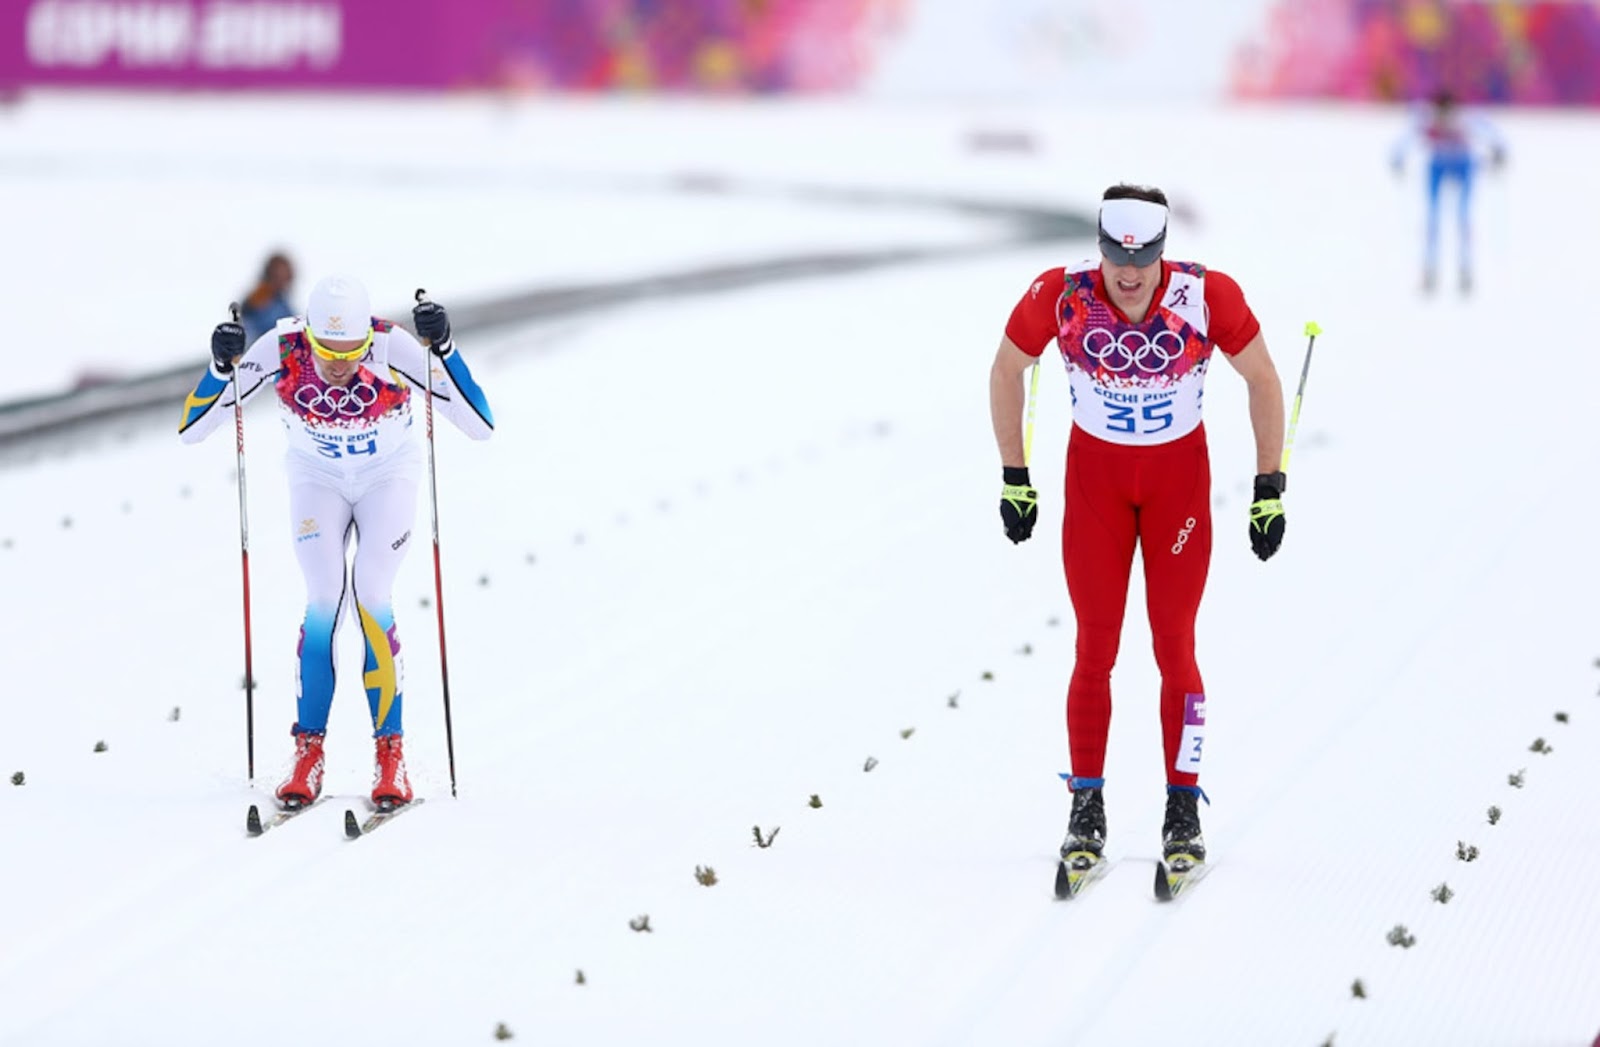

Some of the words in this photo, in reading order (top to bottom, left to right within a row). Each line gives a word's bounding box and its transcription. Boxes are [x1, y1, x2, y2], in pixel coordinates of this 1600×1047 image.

[1094, 387, 1137, 403] SOCHI
[1104, 400, 1173, 433] 35
[312, 438, 376, 458] 34
